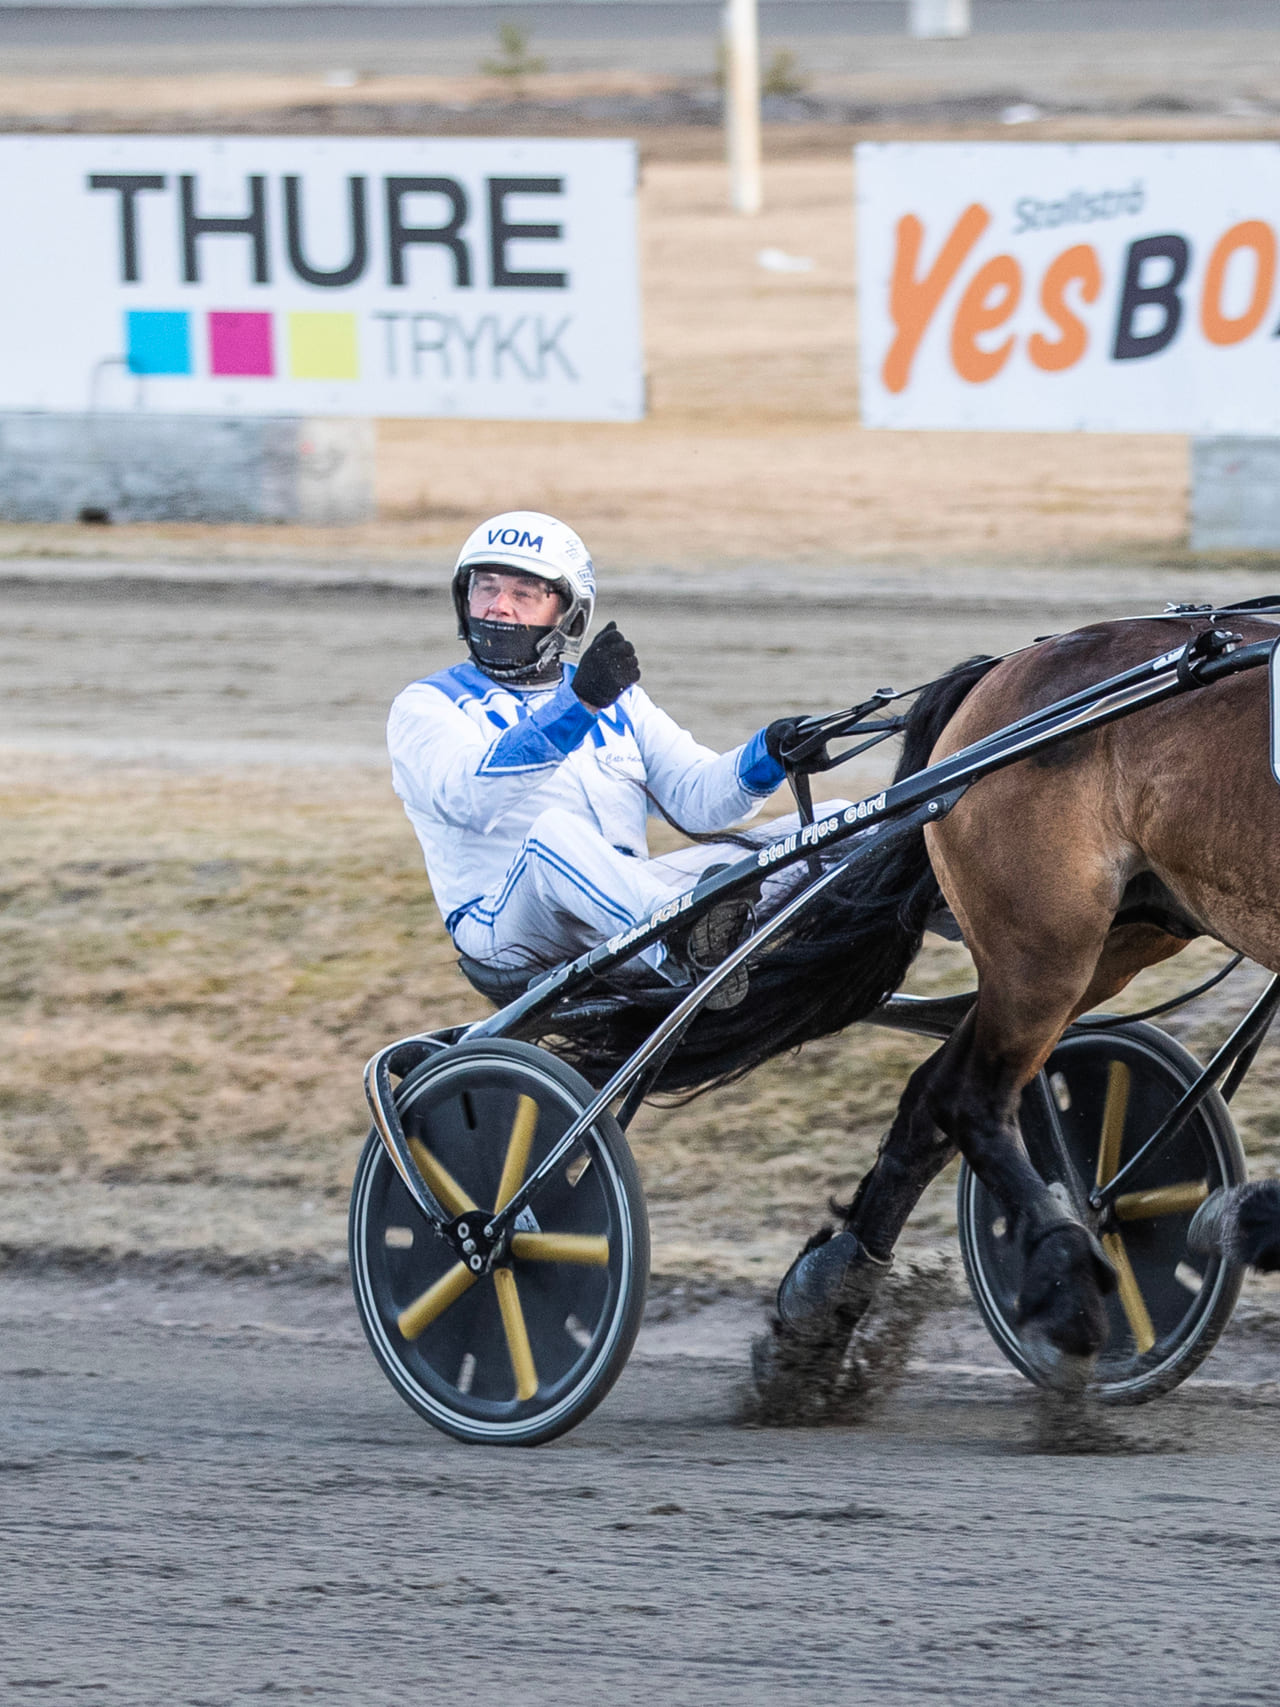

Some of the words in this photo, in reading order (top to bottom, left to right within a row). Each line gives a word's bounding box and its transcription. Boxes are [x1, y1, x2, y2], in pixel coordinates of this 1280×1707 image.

[87, 173, 570, 289] THURE
[372, 311, 579, 382] TRYKK
[487, 528, 544, 553] VOM
[758, 833, 798, 867] Stall
[801, 817, 839, 846] Fjøs
[843, 792, 887, 824] Gård
